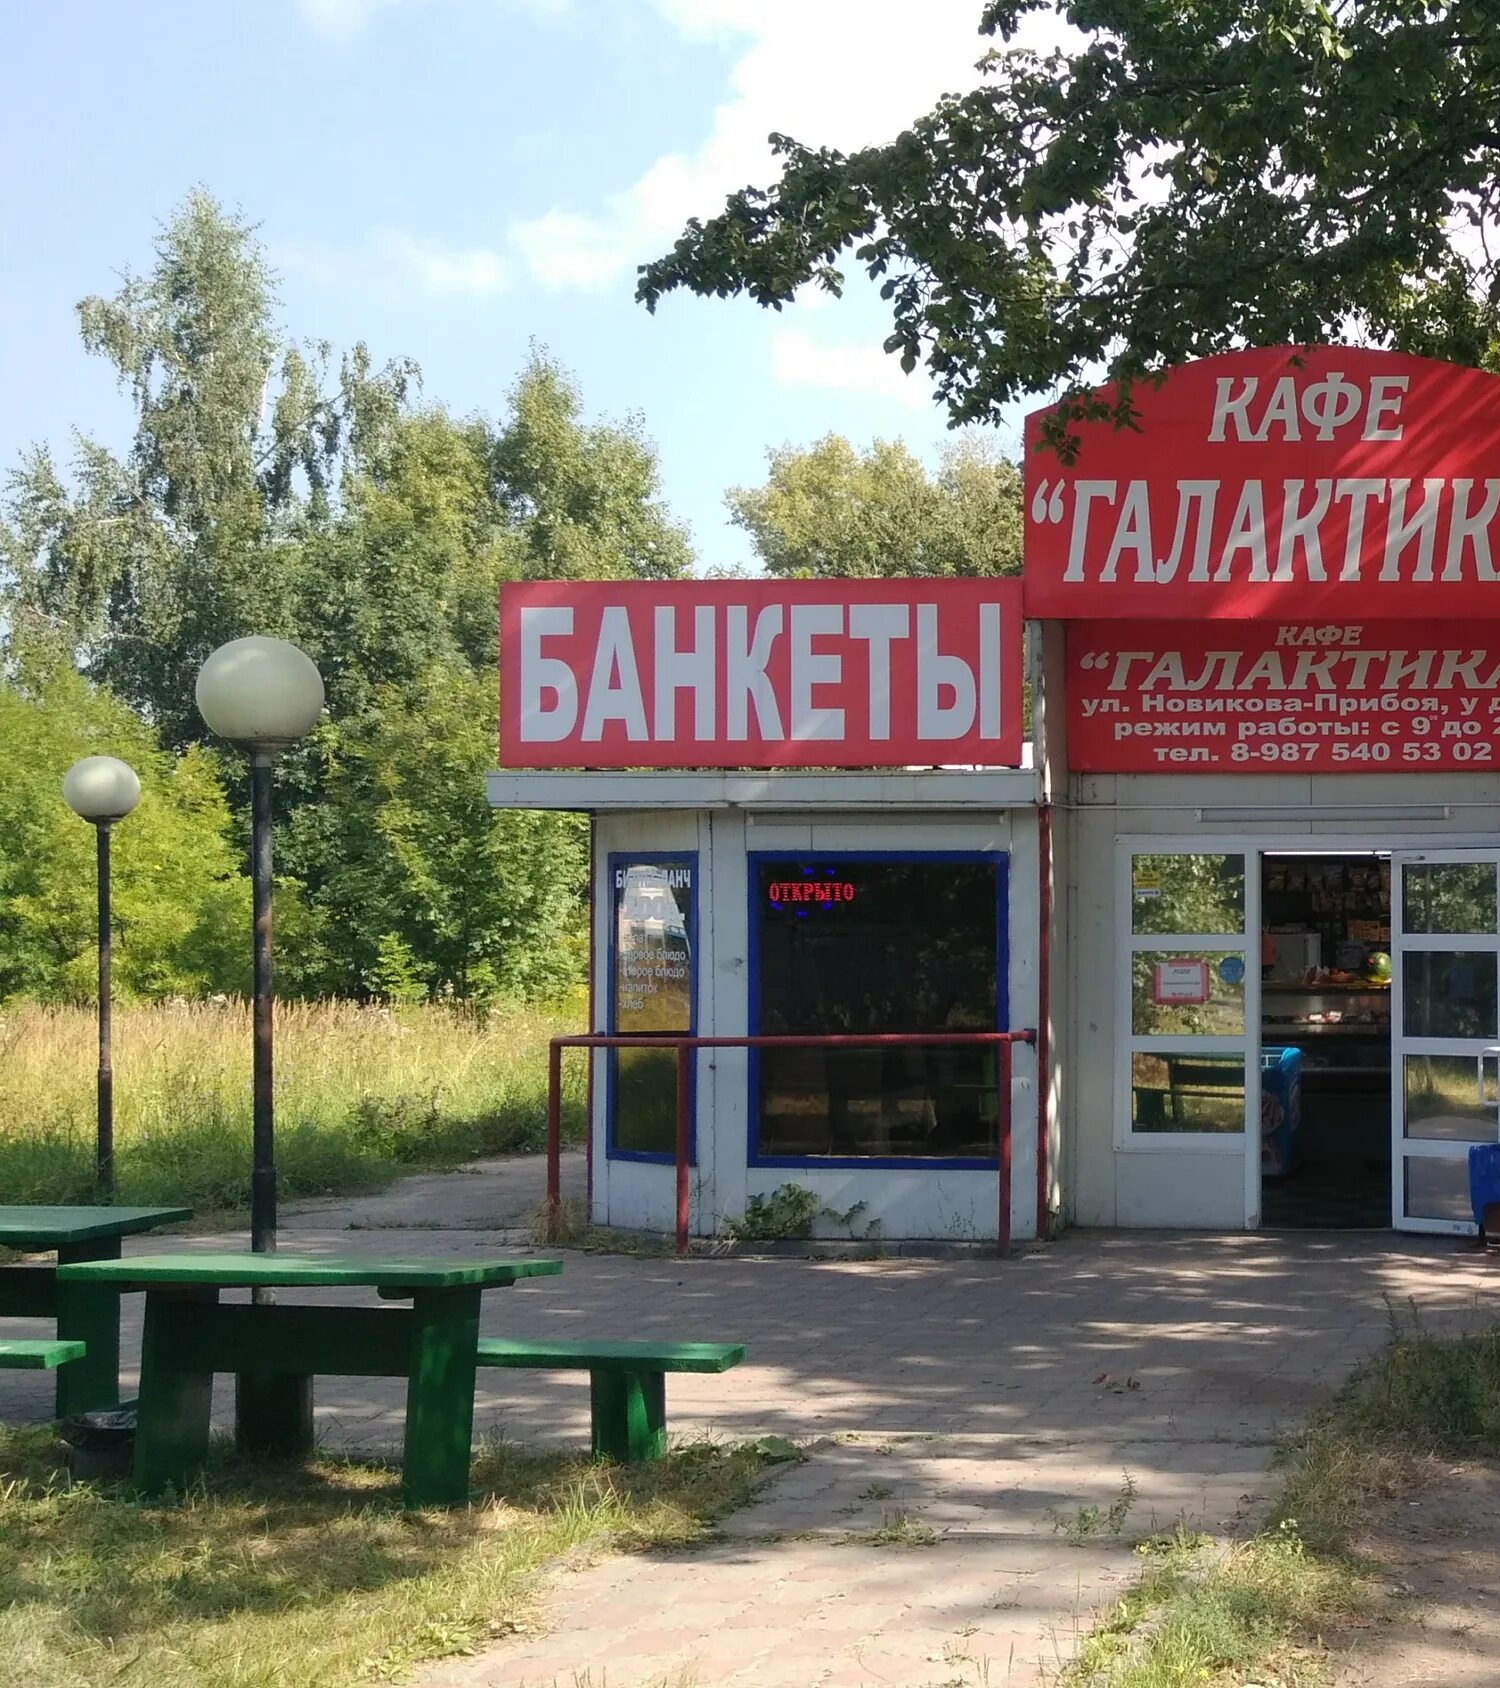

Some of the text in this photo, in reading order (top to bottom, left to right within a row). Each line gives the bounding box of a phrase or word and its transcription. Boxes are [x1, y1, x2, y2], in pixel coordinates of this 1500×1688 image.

[1207, 371, 1410, 442] КАФЕ
[1274, 625, 1364, 646] КАФЕ
[520, 603, 1001, 742] БАНКЕТЫ
[1082, 697, 1130, 717] ул.
[1142, 692, 1449, 716] Новикова-Прибоя,
[1460, 697, 1479, 715] у
[1114, 721, 1227, 740] режим
[1238, 716, 1370, 740] работы:
[1381, 721, 1400, 735] с
[1441, 721, 1482, 738] до
[1153, 743, 1492, 762] тел. 8-987 540 53 02
[769, 882, 854, 902] ОТКРЫТО
